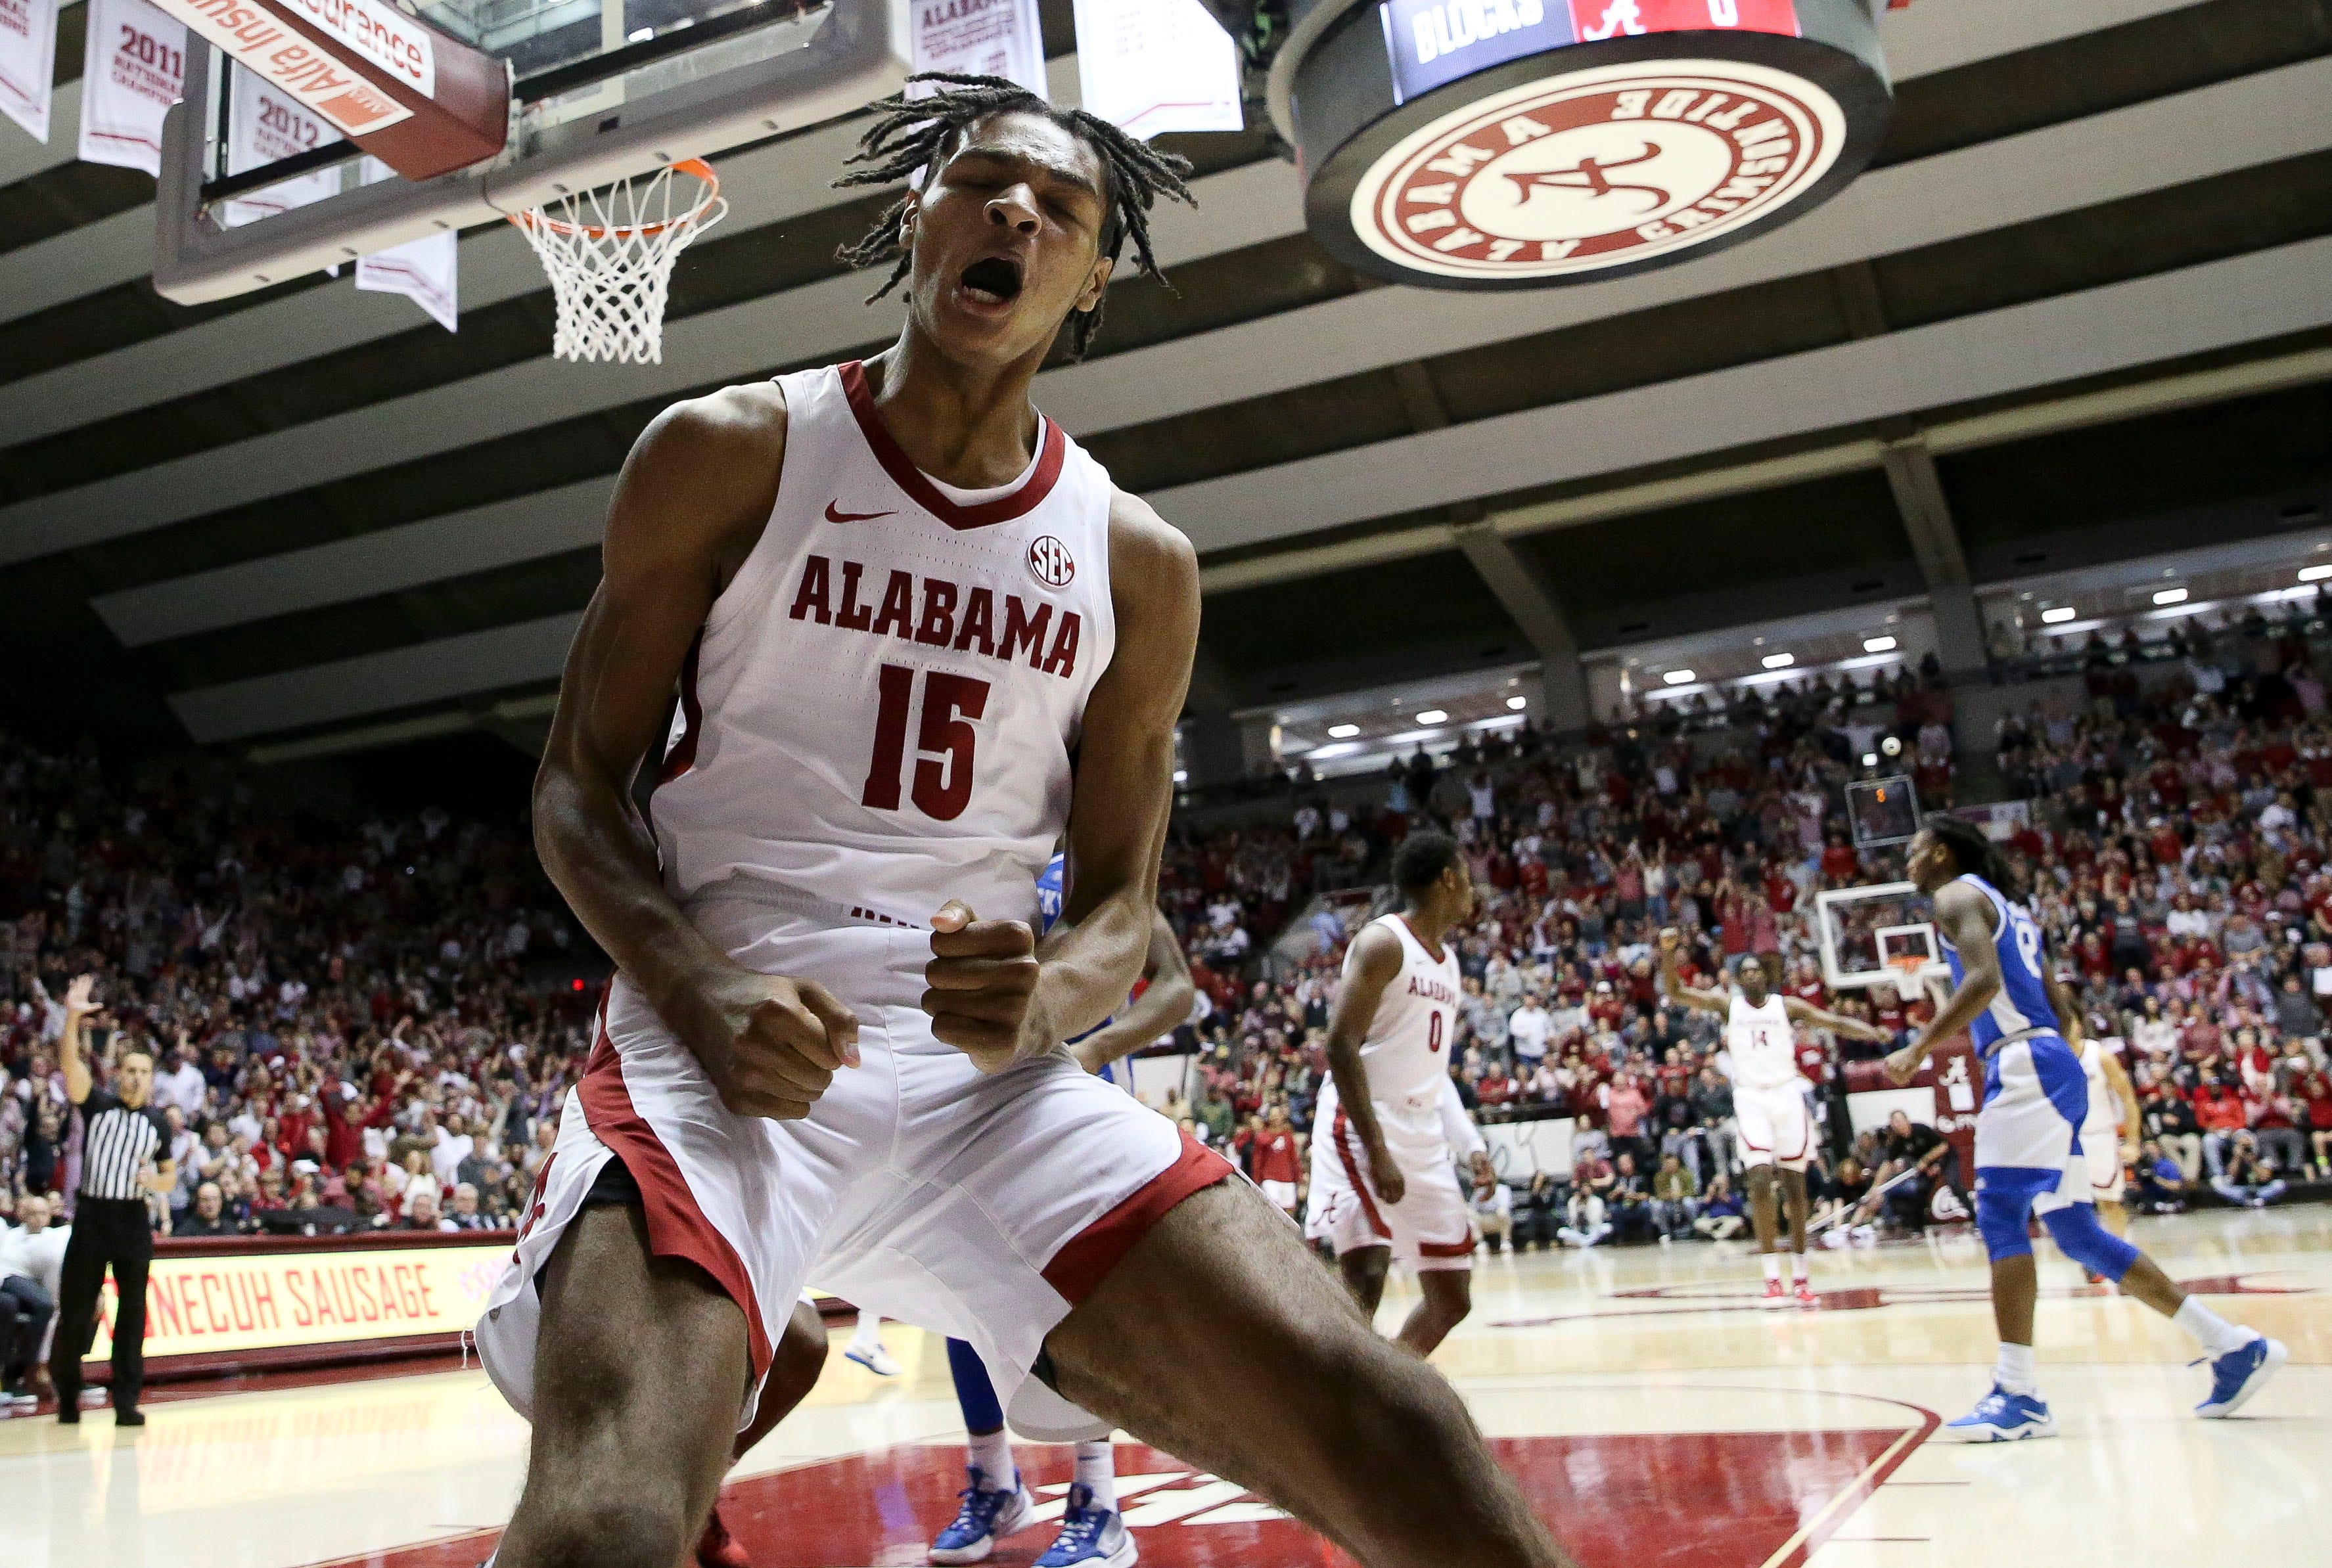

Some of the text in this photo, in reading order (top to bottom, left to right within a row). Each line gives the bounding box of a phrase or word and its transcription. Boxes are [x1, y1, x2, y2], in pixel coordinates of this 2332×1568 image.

[120, 23, 181, 79] 2011
[187, 0, 352, 92] Alfa Insu
[1412, 0, 1544, 64] BLOCKS
[259, 96, 319, 146] 2012
[1611, 89, 1760, 131] TIDE
[1406, 116, 1582, 261] ALABAMA
[1636, 118, 1793, 242] CRIMSON
[1032, 537, 1073, 585] SEC
[789, 555, 1082, 679] ALABAMA
[861, 663, 991, 821] 15
[1429, 1011, 1442, 1052] 0
[101, 1265, 439, 1340] NECUH SAUSAGE
